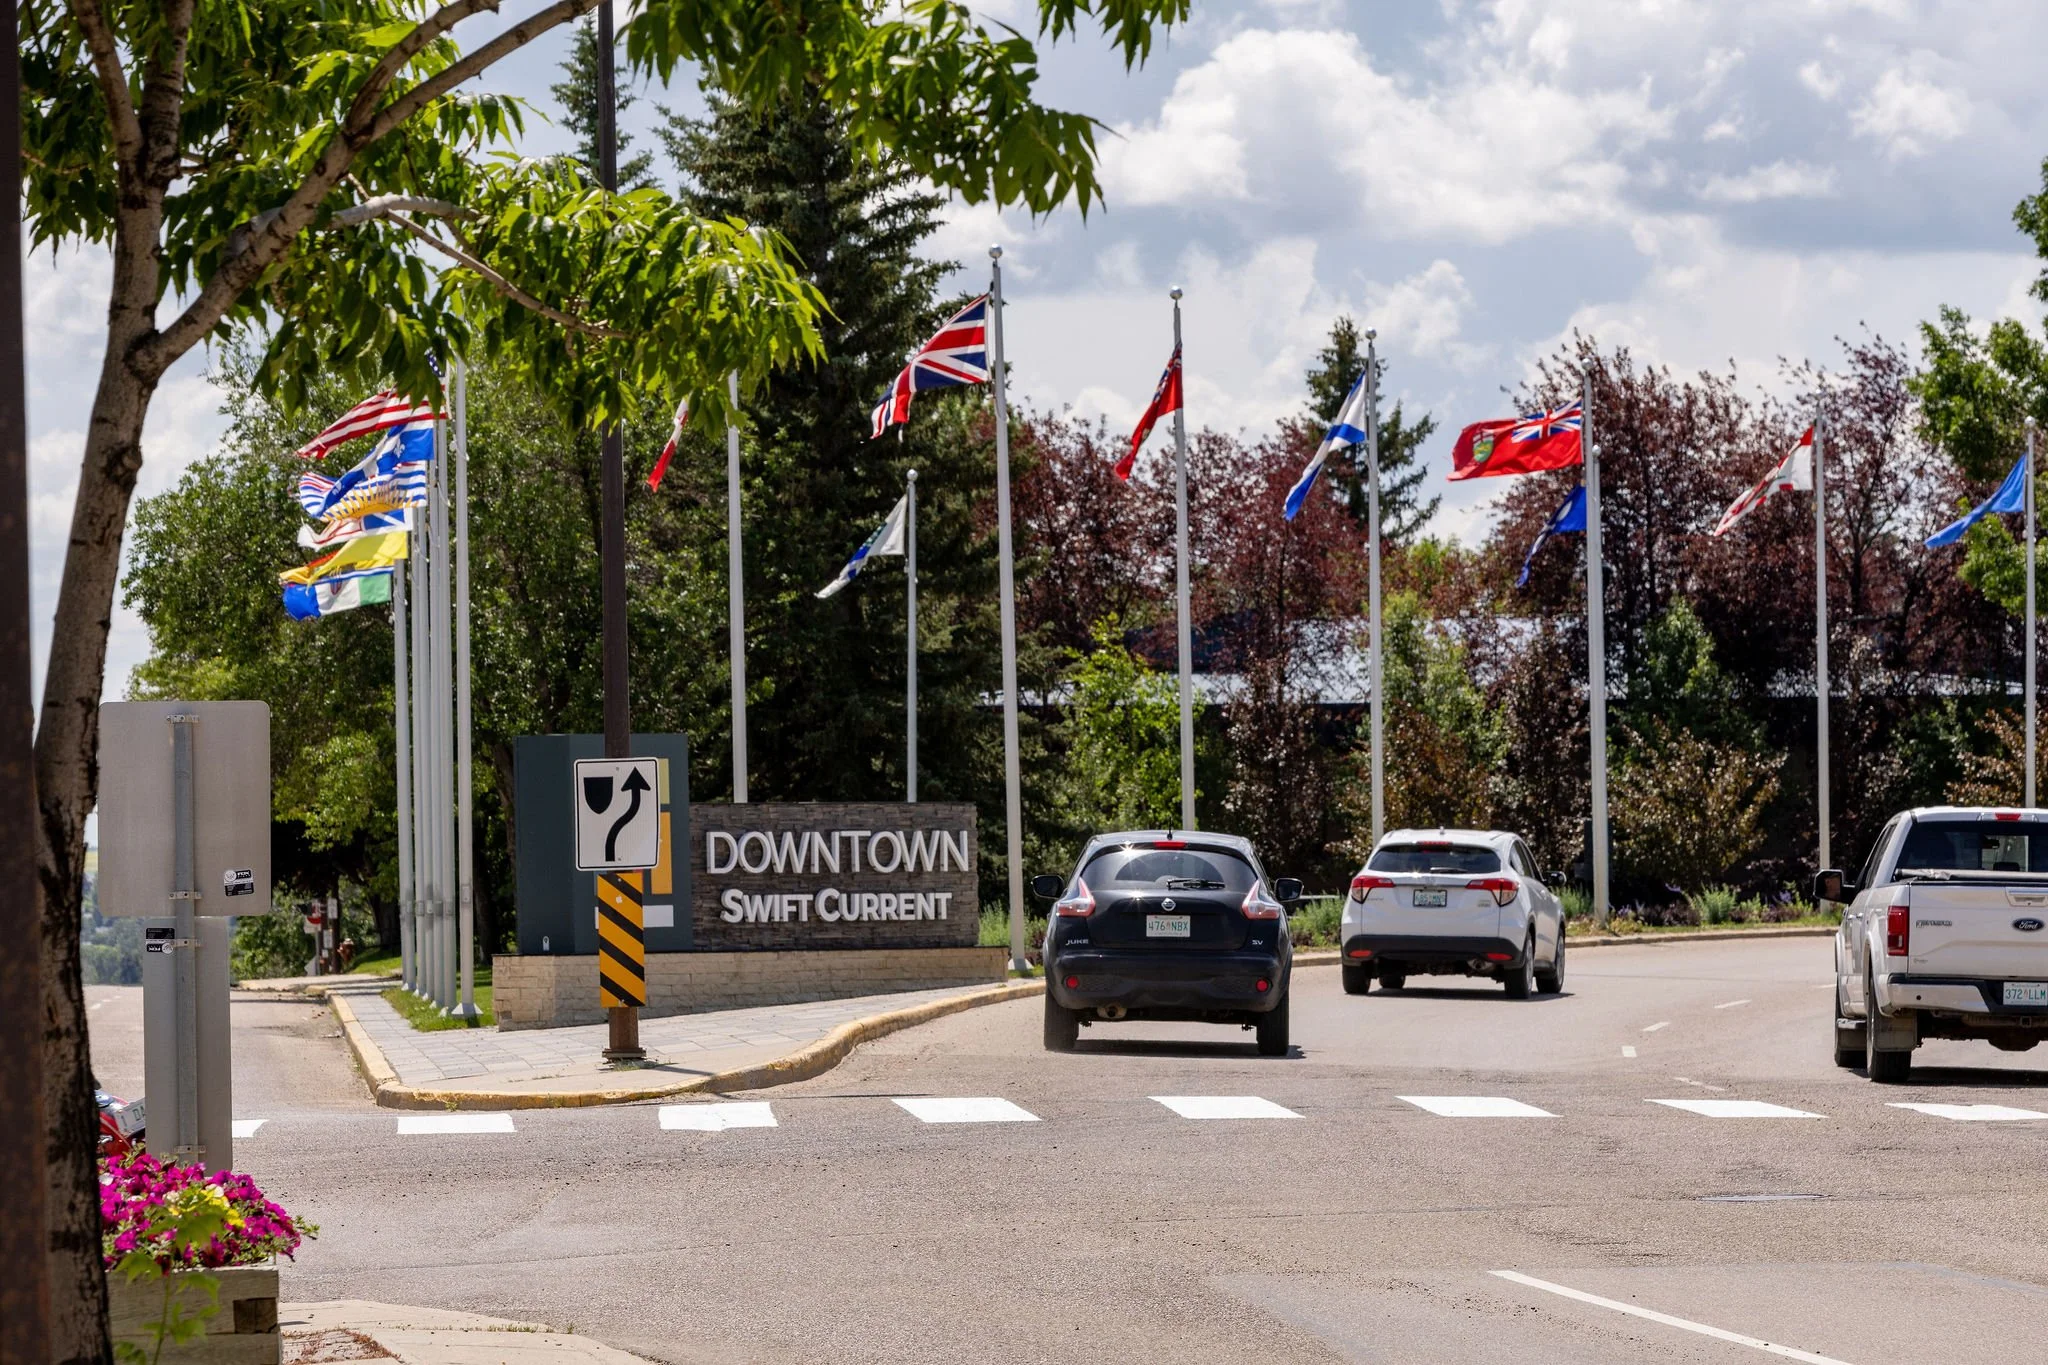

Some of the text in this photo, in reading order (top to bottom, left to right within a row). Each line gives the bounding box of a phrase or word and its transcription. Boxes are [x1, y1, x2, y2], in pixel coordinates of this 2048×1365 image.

[706, 830, 969, 875] DOWNTOWN
[720, 887, 952, 924] SWIFT CURRENT
[1148, 920, 1188, 932] 476 NBX
[2018, 920, 2039, 930] Ford
[1065, 938, 1089, 946] JUKE
[2005, 988, 2046, 1000] 372 LLM
